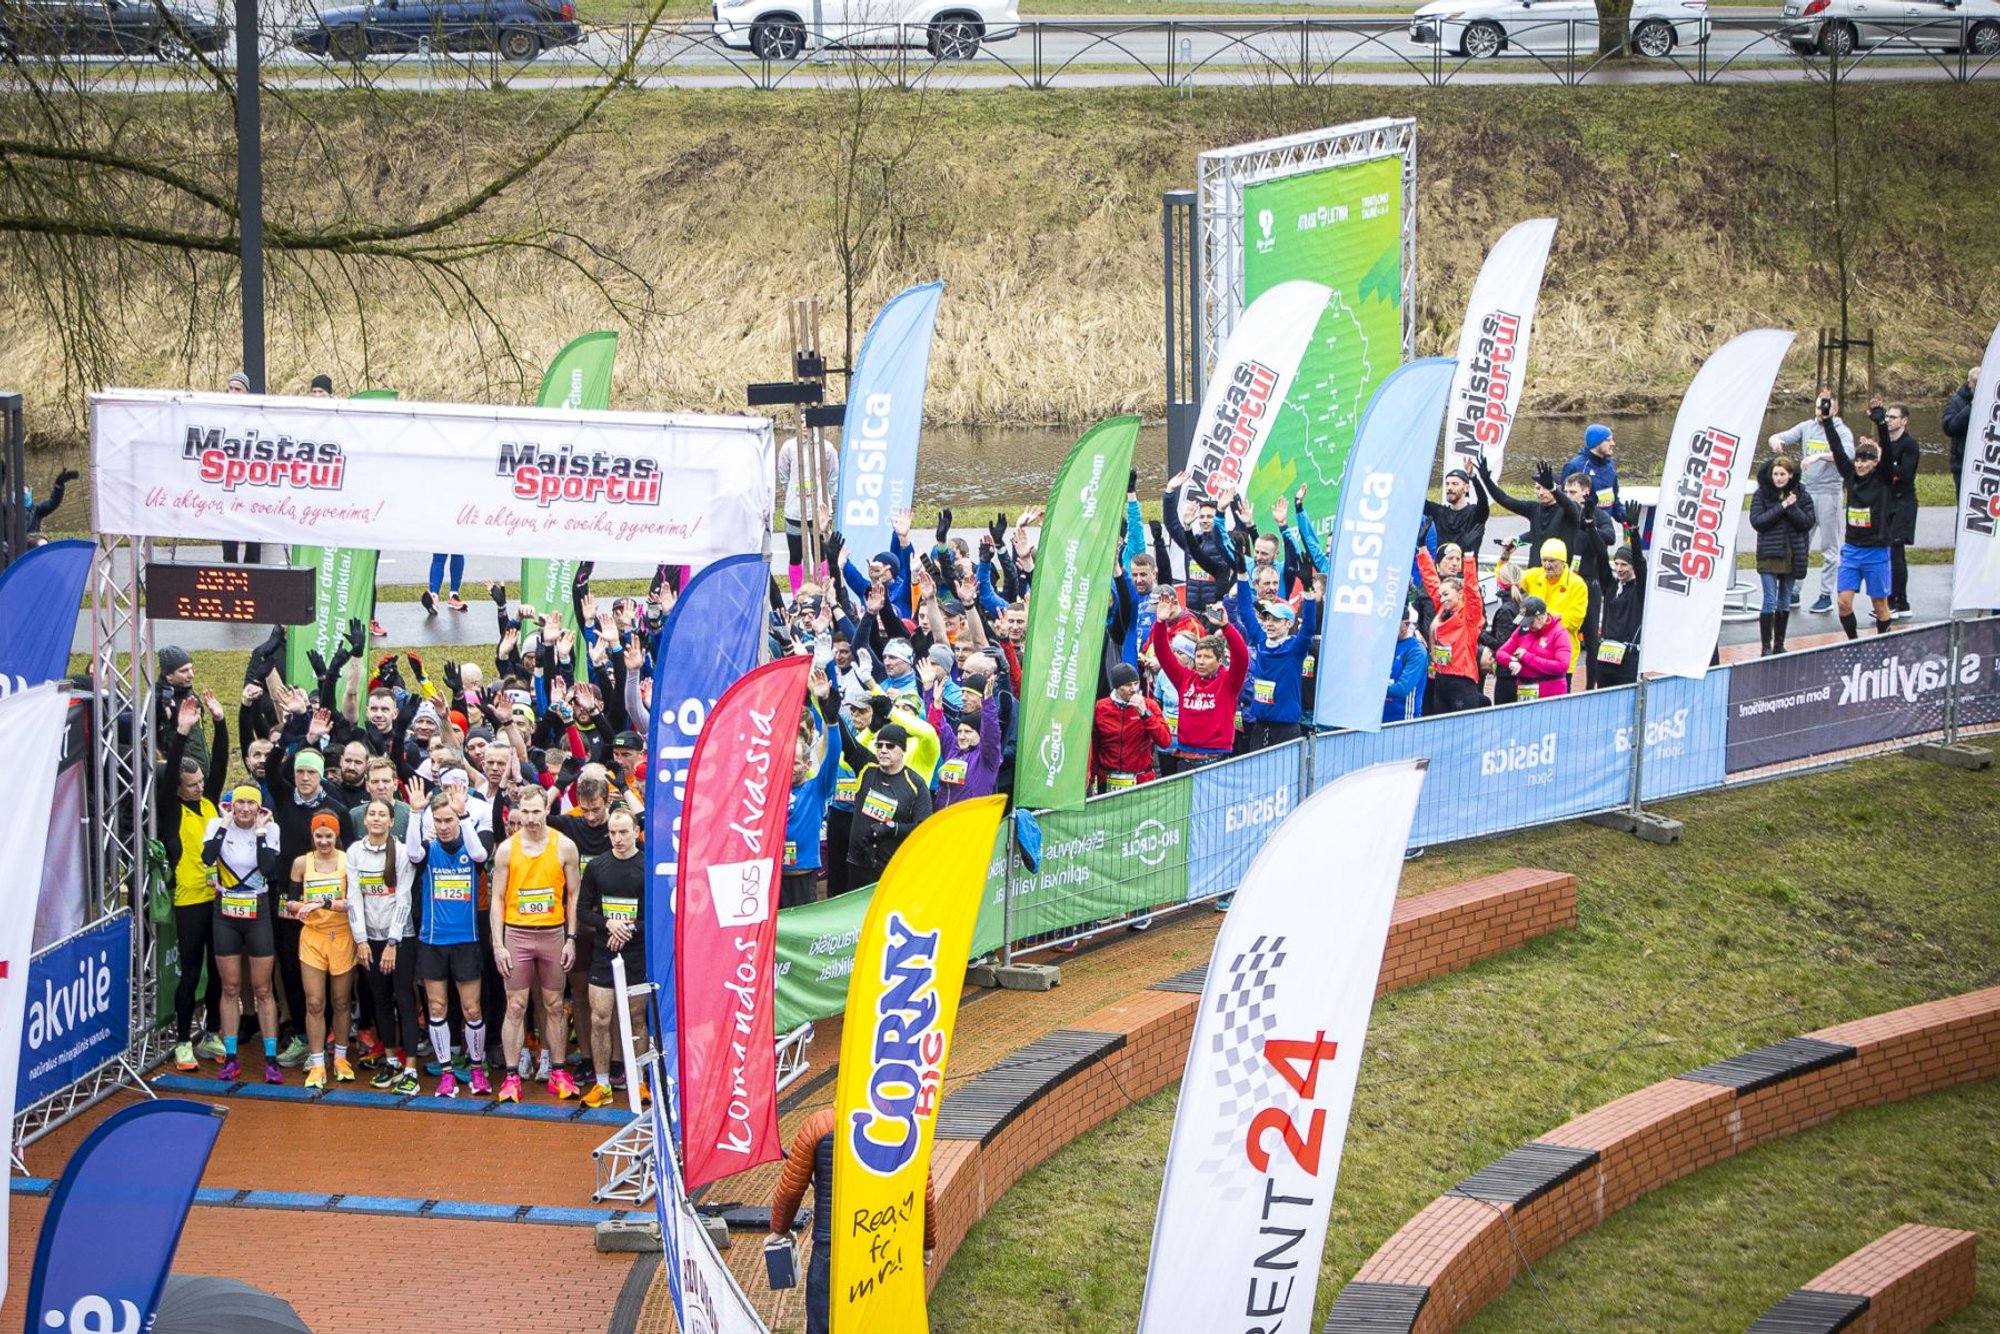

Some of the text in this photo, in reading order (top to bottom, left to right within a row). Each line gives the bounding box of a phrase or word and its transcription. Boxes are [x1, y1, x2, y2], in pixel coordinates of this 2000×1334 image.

[569, 369, 583, 405] chem
[1453, 314, 1500, 457] Maistas
[1475, 310, 1520, 445] Sportui
[183, 425, 342, 463] Maistas
[1184, 362, 1254, 502] Maistas
[1205, 360, 1280, 498] Sportui
[200, 449, 346, 490] Sportui
[497, 442, 659, 478] Maistas
[845, 392, 892, 526] Basica
[1964, 382, 2000, 536] Maist
[145, 487, 385, 526] Už aktyvą ir sveiką gyvenimą!
[514, 465, 663, 507] Sportui
[1680, 426, 1740, 581] Sportui
[456, 504, 702, 542] Už aktyvą ir sveiką gyvenimą!
[1655, 430, 1712, 596] Maistas
[320, 546, 337, 588] draug
[1333, 470, 1394, 615] Basica
[1377, 566, 1401, 619] Sport
[1056, 611, 1068, 624] ir
[730, 706, 776, 855] dvasia
[233, 907, 245, 915] 15
[371, 886, 383, 894] 86
[444, 889, 462, 899] 125
[530, 903, 543, 912] 90
[28, 950, 110, 1049] akvilė
[852, 913, 939, 1174] CORNY
[916, 1033, 943, 1116] BIG
[853, 1191, 914, 1237] Reay
